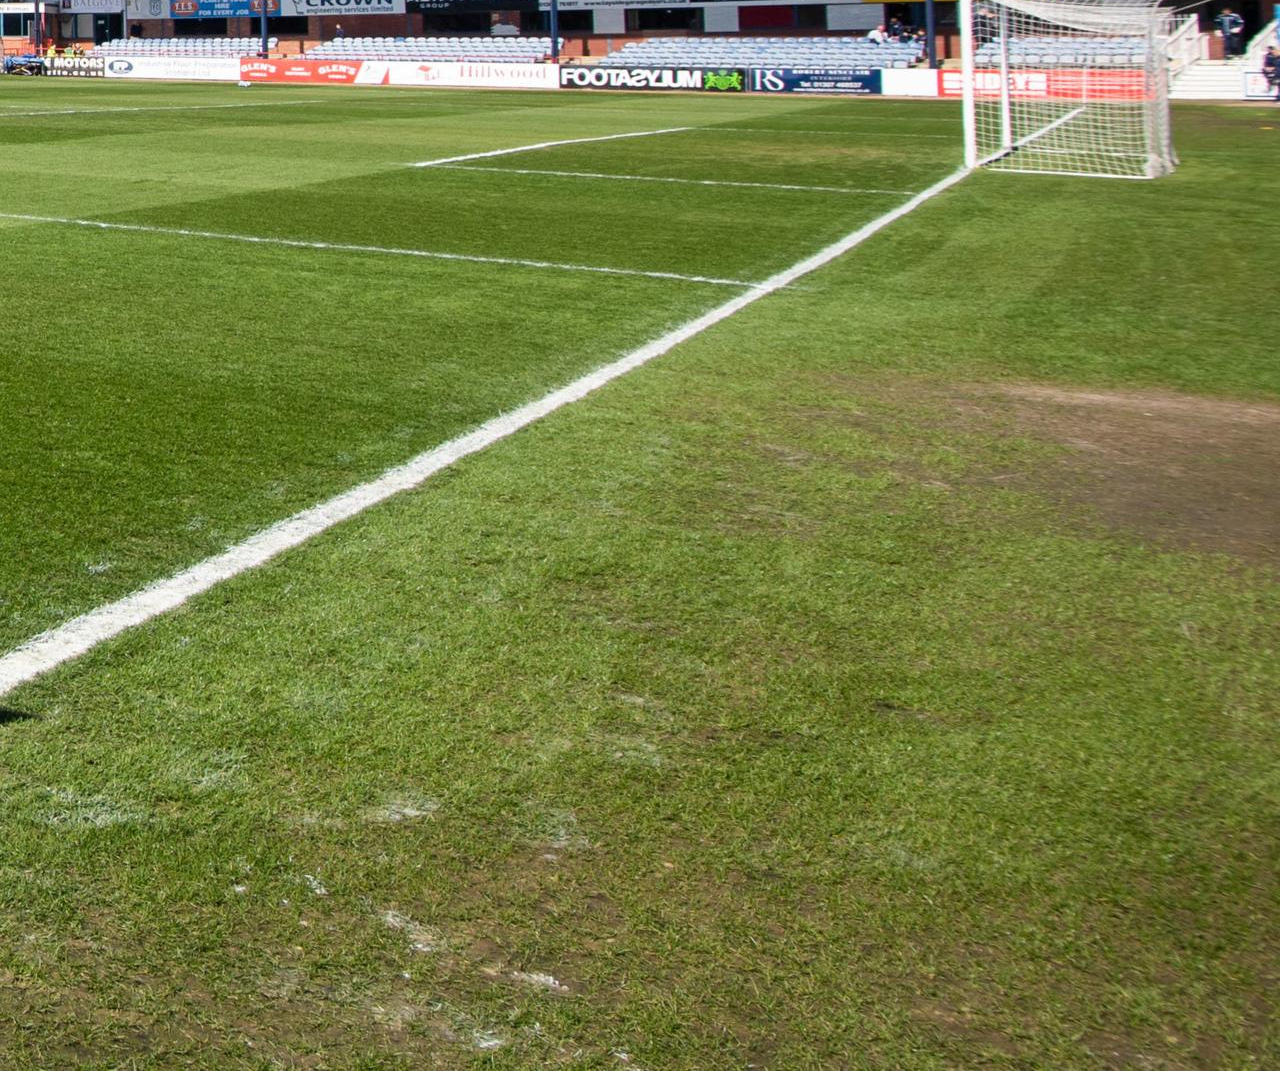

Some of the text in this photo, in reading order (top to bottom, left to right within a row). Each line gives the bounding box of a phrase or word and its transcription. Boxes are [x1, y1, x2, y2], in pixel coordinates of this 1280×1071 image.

[306, 6, 343, 15] engineering
[370, 5, 394, 13] limited
[53, 57, 104, 69] MOTORS
[240, 62, 276, 73] GLEN'S
[318, 64, 357, 75] GLEN'S
[459, 65, 546, 79] Hillwood
[560, 68, 703, 88] FOOTASYLUM
[754, 69, 784, 91] RS
